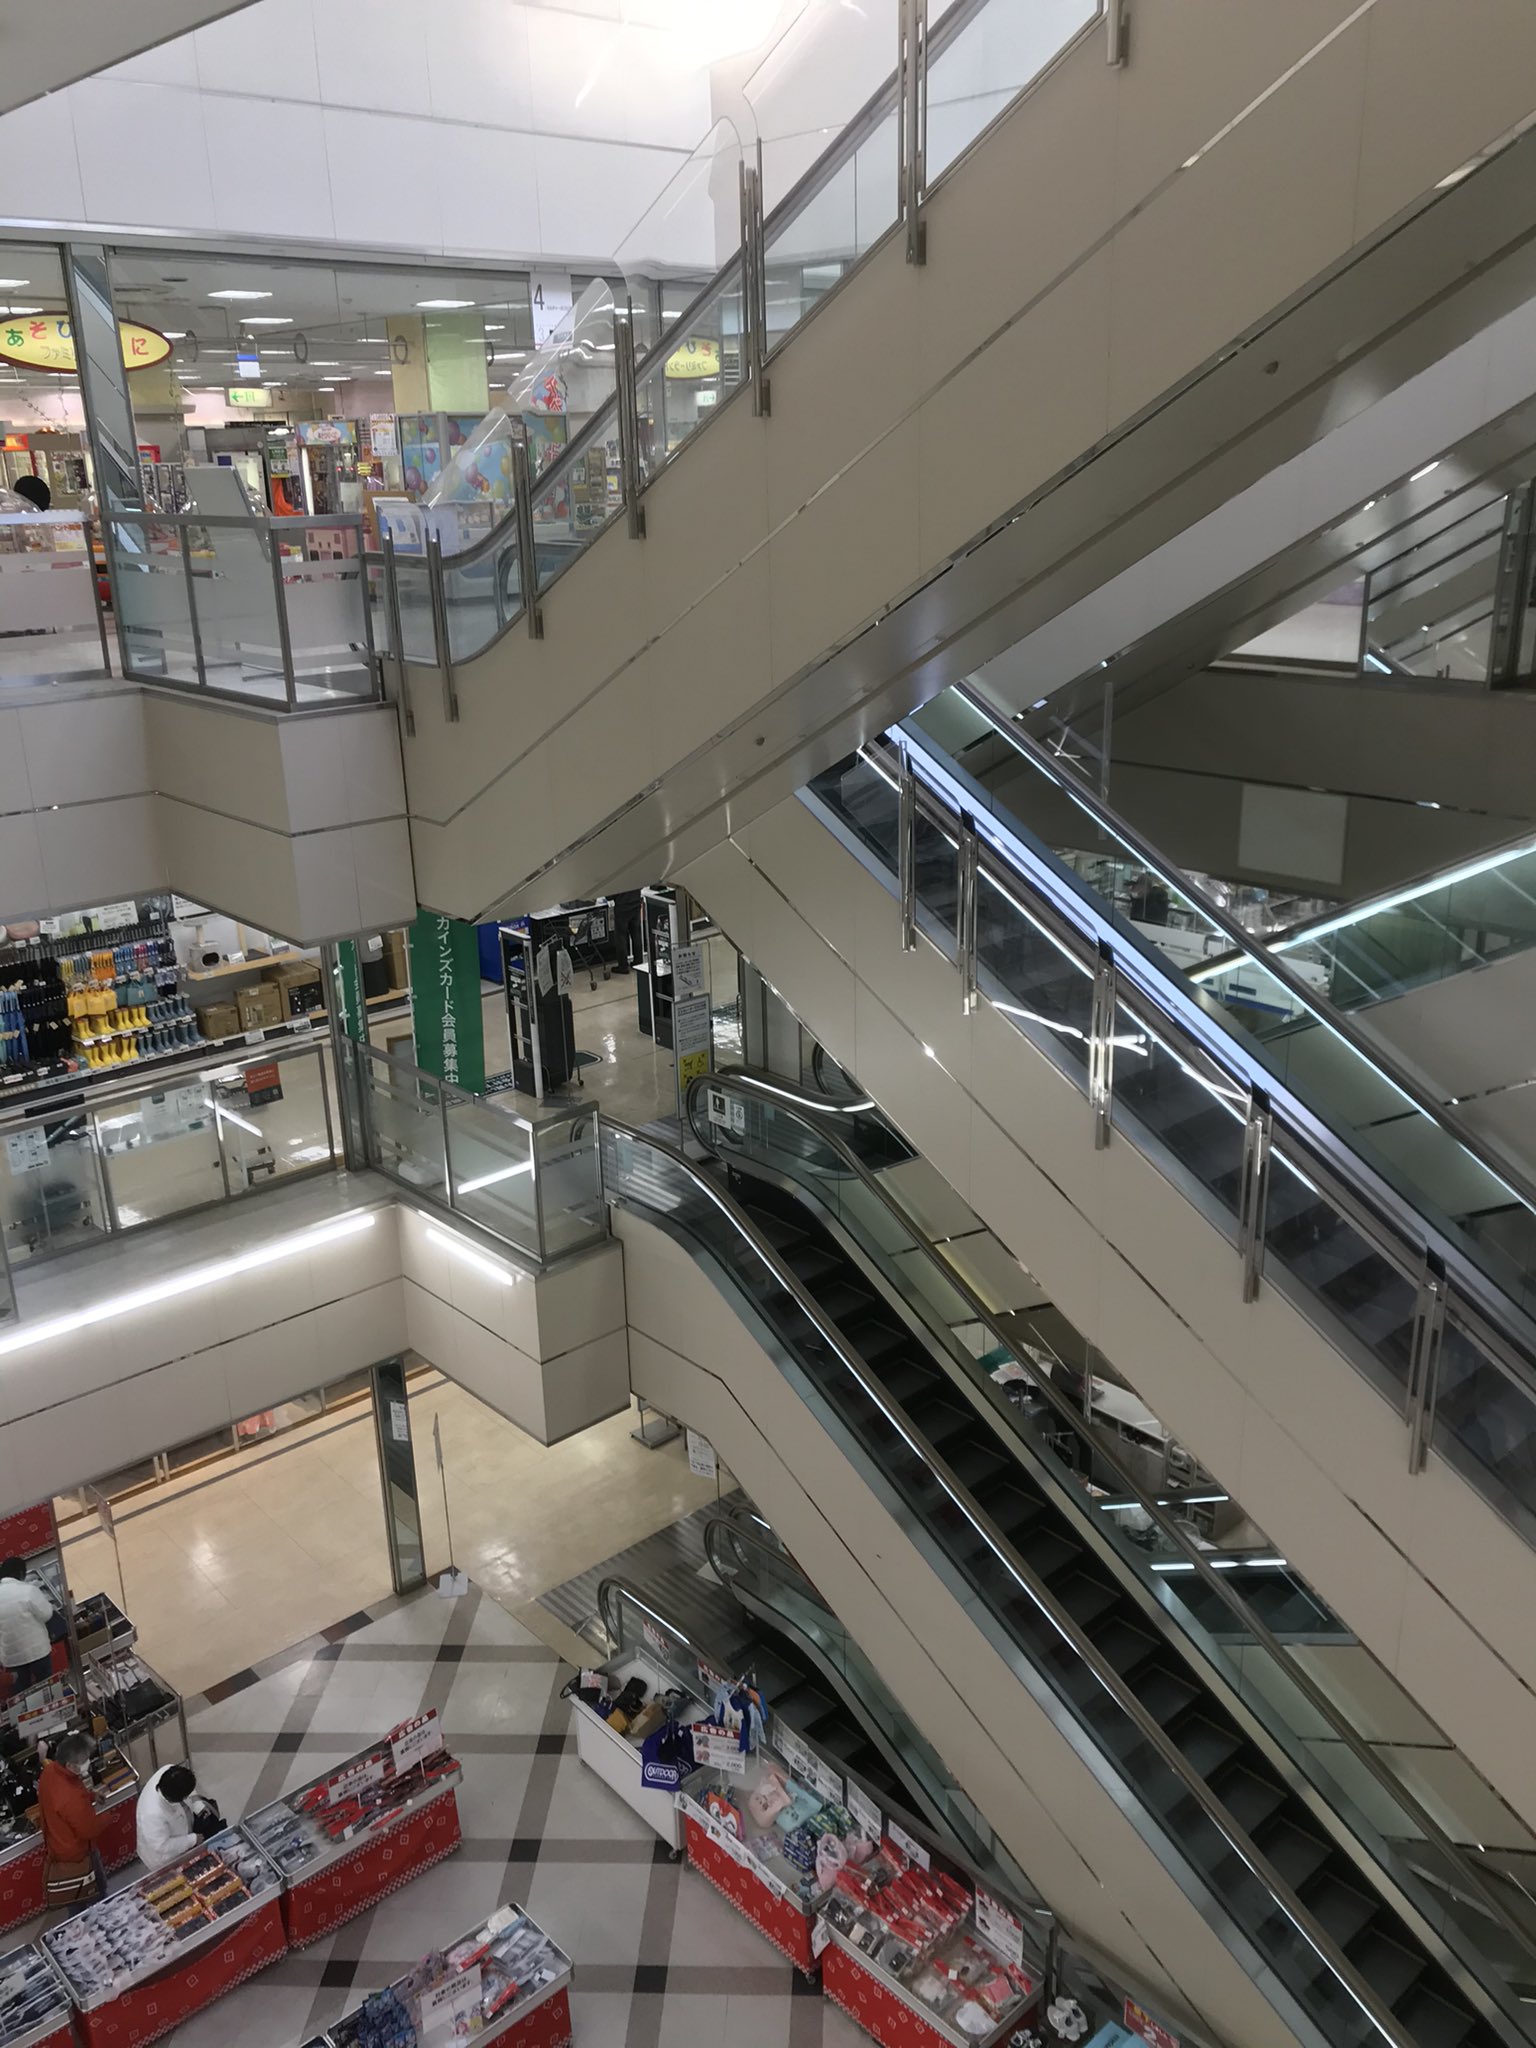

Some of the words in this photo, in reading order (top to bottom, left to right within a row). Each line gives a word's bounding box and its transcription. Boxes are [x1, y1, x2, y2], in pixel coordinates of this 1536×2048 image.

[534, 283, 545, 311] 4
[436, 916, 459, 1084] カインズカード会員募集中
